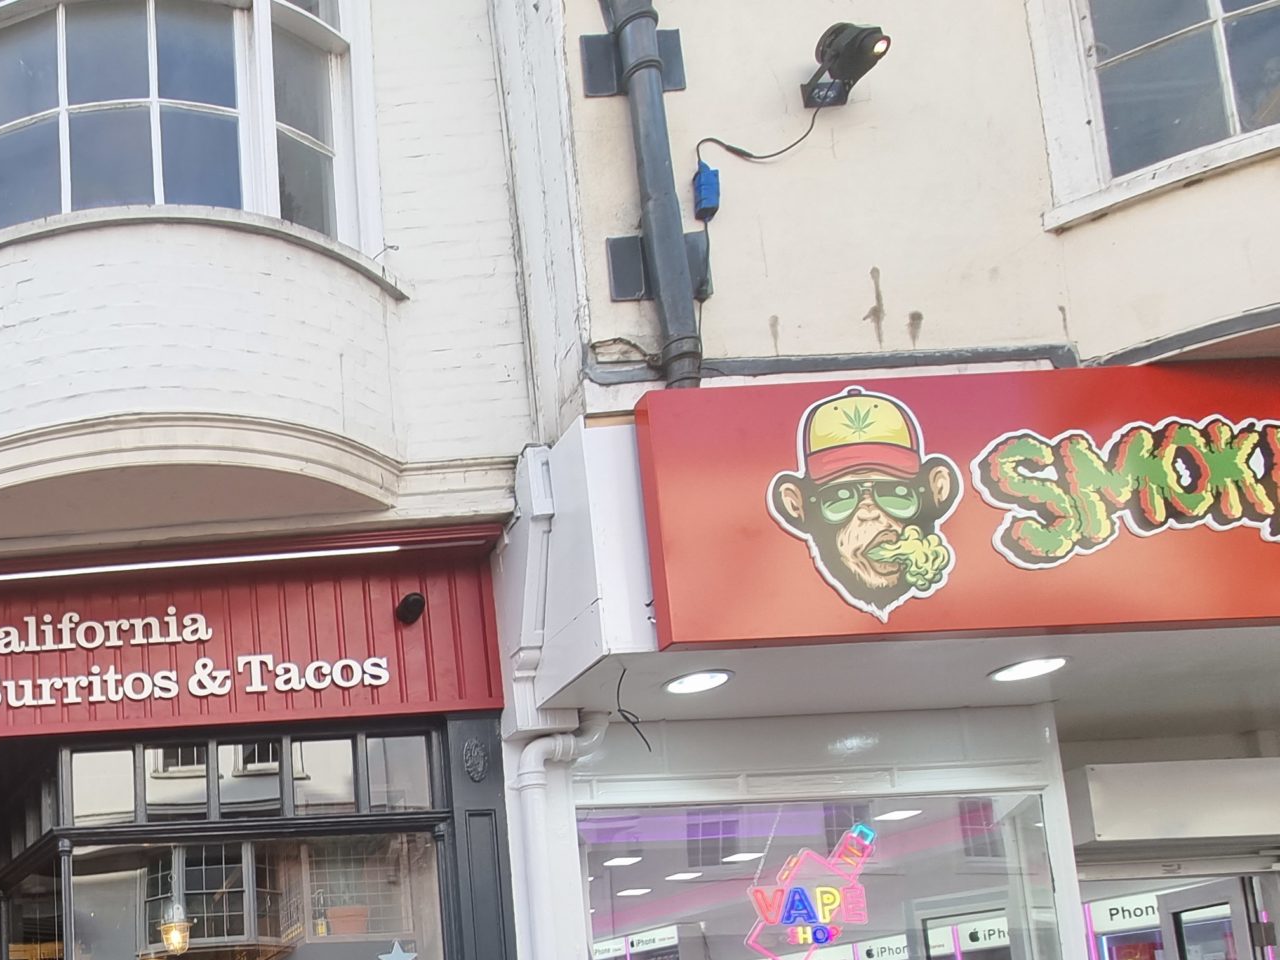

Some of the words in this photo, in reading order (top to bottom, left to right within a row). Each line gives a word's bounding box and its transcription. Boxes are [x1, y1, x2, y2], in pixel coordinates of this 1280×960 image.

[976, 417, 1280, 564] SMOK
[188, 657, 231, 696] &
[238, 654, 389, 692] Tacos
[752, 886, 867, 924] VAPE
[1109, 905, 1159, 921] Phon
[635, 938, 656, 947] iPhone
[787, 925, 842, 944] SHOP
[983, 929, 1009, 941] iPh
